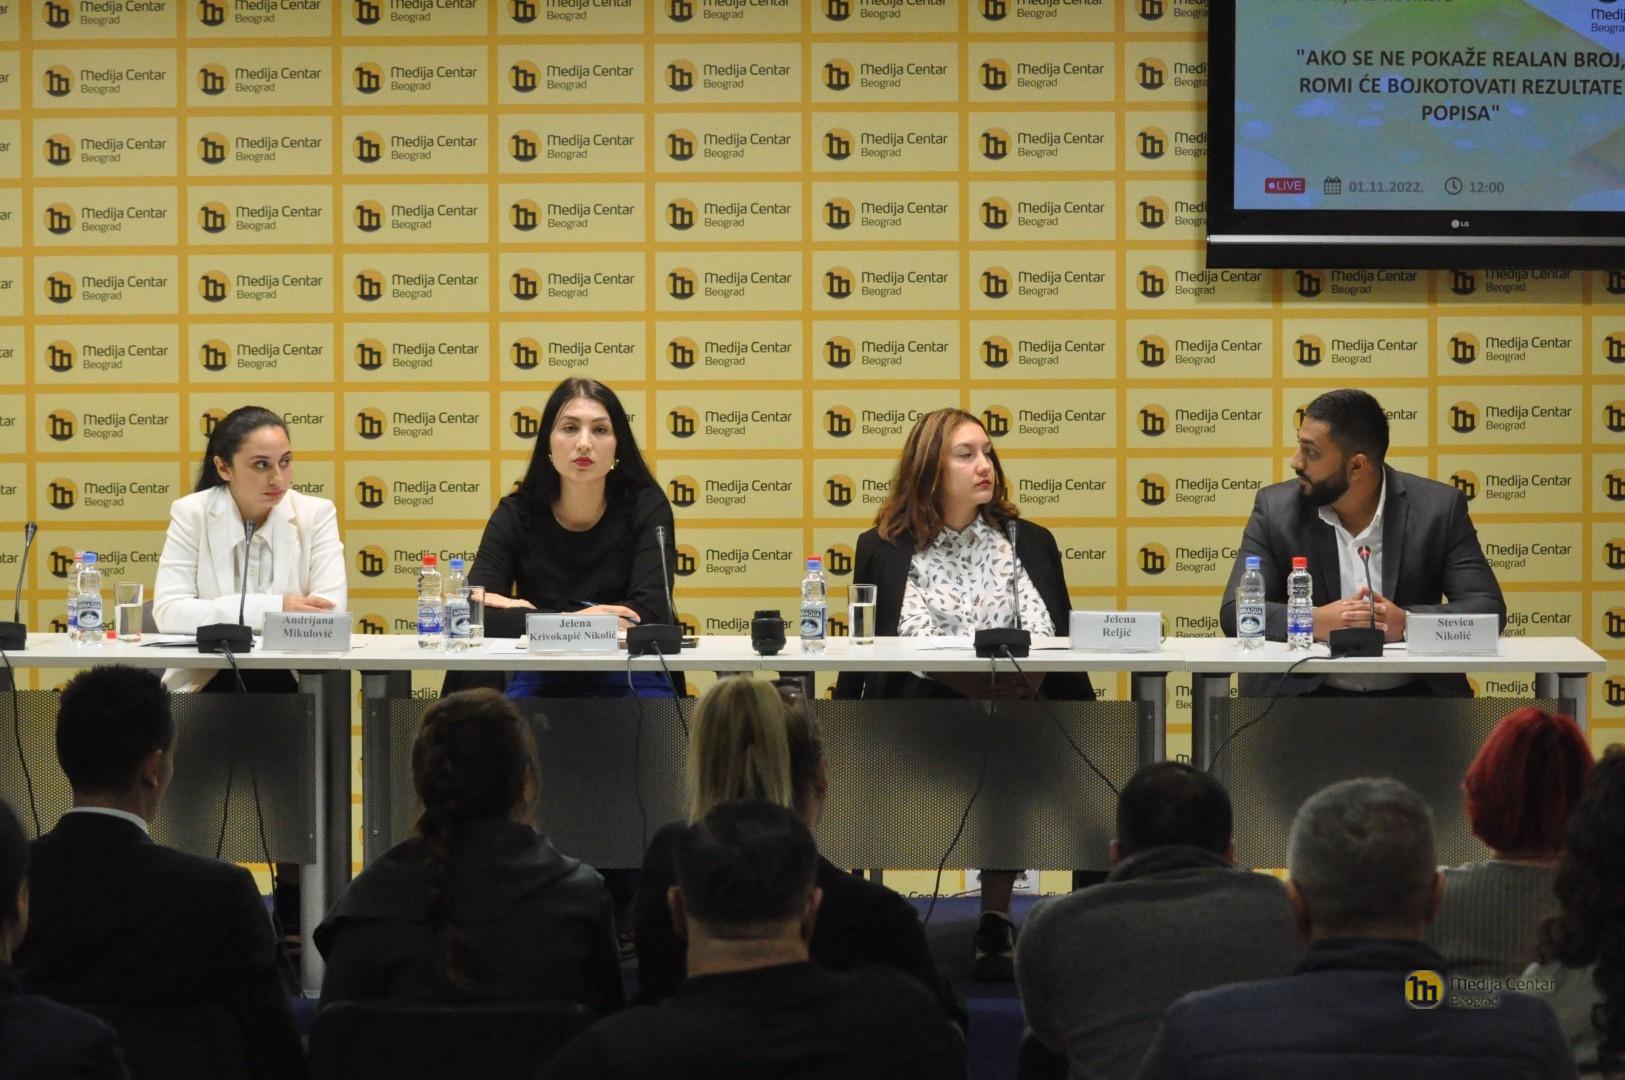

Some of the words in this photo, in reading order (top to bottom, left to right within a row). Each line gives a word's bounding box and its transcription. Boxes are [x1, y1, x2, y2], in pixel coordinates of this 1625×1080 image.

[1296, 48, 1347, 67] "AKO
[1352, 50, 1375, 67] SE
[1380, 51, 1406, 67] NE
[1411, 47, 1487, 68] POKAŽE
[1493, 51, 1567, 69] REALAN
[80, 69, 123, 84] Medija
[126, 68, 167, 81] Centar
[390, 66, 433, 81] Medija
[436, 65, 477, 78] Centar
[546, 65, 589, 80] Medija
[592, 64, 633, 77] Centar
[703, 64, 746, 79] Medija
[749, 63, 790, 76] Centar
[1017, 63, 1060, 78] Medija
[1063, 62, 1104, 75] Centar
[81, 84, 120, 95] Beograd
[391, 81, 431, 92] Beograd
[547, 80, 587, 91] Beograd
[704, 79, 744, 90] Beograd
[1018, 78, 1057, 89] Beograd
[1300, 77, 1353, 94] ROMI
[1358, 73, 1381, 94] ĆE
[1387, 78, 1516, 95] BOJKOTOVATI
[1522, 78, 1623, 96] REZULTATE
[1421, 105, 1500, 122] POPISA"
[235, 137, 278, 152] Medija
[281, 136, 322, 149] Centar
[391, 136, 434, 151] Medija
[437, 135, 478, 148] Centar
[703, 133, 746, 148] Medija
[749, 132, 790, 145] Centar
[860, 133, 903, 148] Medija
[906, 132, 947, 145] Centar
[1017, 132, 1060, 147] Medija
[1063, 131, 1104, 144] Centar
[236, 152, 275, 162] Beograd
[392, 151, 431, 161] Beograd
[704, 148, 744, 159] Beograd
[861, 148, 901, 159] Beograd
[1018, 147, 1058, 158] Beograd
[1276, 179, 1302, 191] LIVE
[1349, 181, 1424, 194] 01.11.2022.
[1469, 181, 1505, 194] 12:00
[81, 207, 124, 222] Medija
[127, 206, 168, 219] Centar
[547, 204, 590, 219] Medija
[593, 203, 634, 216] Centar
[704, 203, 747, 218] Medija
[750, 202, 791, 215] Centar
[1017, 202, 1060, 217] Medija
[1063, 201, 1104, 214] Centar
[82, 222, 121, 233] Beograd
[548, 219, 587, 230] Beograd
[705, 218, 744, 229] Beograd
[1018, 217, 1058, 228] Beograd
[236, 275, 279, 290] Medija
[282, 274, 323, 287] Centar
[392, 274, 435, 289] Medija
[438, 273, 479, 286] Centar
[861, 271, 904, 286] Medija
[907, 270, 948, 283] Centar
[1018, 271, 1061, 286] Medija
[1064, 270, 1105, 283] Centar
[1175, 271, 1218, 286] Medija
[1221, 270, 1262, 283] Centar
[237, 290, 276, 301] Beograd
[393, 289, 432, 300] Beograd
[862, 286, 901, 297] Beograd
[1019, 286, 1058, 297] Beograd
[1176, 286, 1215, 296] Beograd
[392, 343, 435, 358] Medija
[438, 342, 479, 355] Centar
[548, 342, 591, 357] Medija
[594, 341, 635, 354] Centar
[704, 342, 747, 357] Medija
[750, 341, 791, 354] Centar
[1018, 341, 1061, 356] Medija
[1064, 340, 1105, 353] Centar
[1175, 339, 1218, 354] Medija
[1221, 338, 1262, 351] Centar
[1331, 339, 1374, 354] Medija
[1377, 338, 1418, 351] Centar
[1485, 337, 1528, 352] Medija
[1531, 336, 1572, 349] Centar
[549, 357, 588, 368] Beograd
[705, 357, 745, 367] Beograd
[1019, 356, 1059, 366] Beograd
[1176, 354, 1215, 366] Beograd
[1332, 354, 1371, 365] Beograd
[1486, 352, 1525, 362] Beograd
[393, 358, 432, 369] Beograd
[705, 411, 748, 426] Medija
[751, 410, 792, 423] Centar
[1018, 410, 1061, 425] Medija
[1064, 409, 1105, 422] Centar
[1175, 409, 1218, 424] Medija
[1221, 408, 1262, 421] Centar
[1485, 405, 1528, 420] Medija
[1531, 404, 1572, 417] Centar
[83, 414, 126, 429] Medija
[129, 413, 170, 426] Centar
[1486, 420, 1525, 431] Beograd
[84, 429, 123, 439] Beograd
[706, 426, 745, 437] Beograd
[1019, 425, 1059, 436] Beograd
[1176, 424, 1215, 435] Beograd
[705, 480, 748, 495] Medija
[751, 479, 792, 492] Centar
[1019, 479, 1062, 494] Medija
[1065, 478, 1106, 491] Centar
[1175, 478, 1218, 493] Medija
[1221, 477, 1262, 490] Centar
[1485, 474, 1528, 489] Medija
[1531, 473, 1572, 486] Centar
[83, 482, 126, 497] Medija
[129, 481, 170, 494] Centar
[393, 481, 436, 496] Medija
[439, 480, 480, 493] Centar
[706, 495, 745, 506] Beograd
[1020, 494, 1059, 505] Beograd
[1176, 493, 1215, 504] Beograd
[1486, 489, 1525, 500] Beograd
[84, 497, 123, 508] Beograd
[394, 496, 433, 507] Beograd
[705, 549, 748, 564] Medija
[751, 548, 792, 561] Centar
[1486, 543, 1529, 559] Medija
[1531, 543, 1572, 556] Centar
[706, 564, 746, 575] Beograd
[283, 616, 334, 627] Andrijana
[559, 618, 592, 629] Jelena
[1104, 614, 1136, 624] Jelena
[1437, 617, 1474, 628] Stevica
[283, 627, 333, 639] Mikulović
[530, 631, 582, 643] Krivokapić
[584, 630, 617, 641] Nikolić
[1102, 627, 1132, 638] Reljić
[1435, 630, 1472, 641] Nikolić
